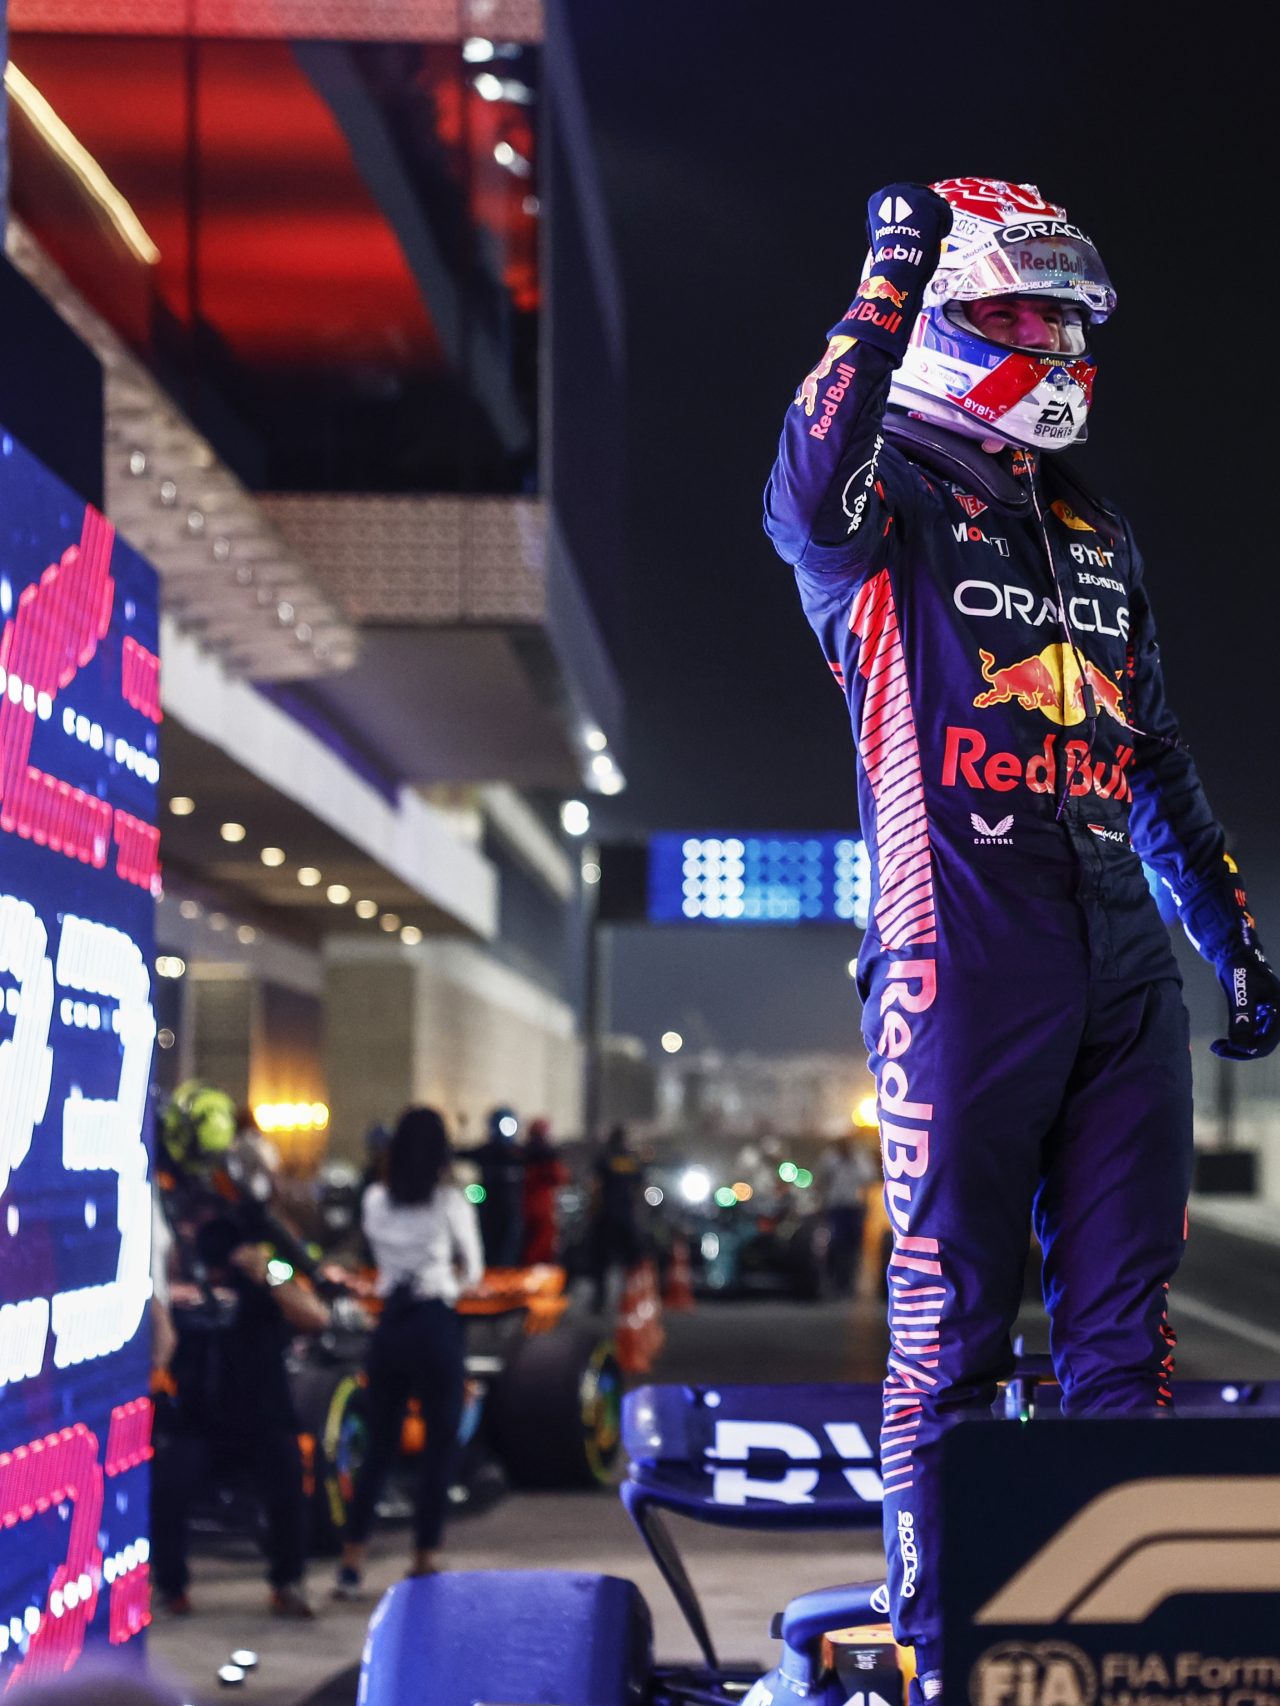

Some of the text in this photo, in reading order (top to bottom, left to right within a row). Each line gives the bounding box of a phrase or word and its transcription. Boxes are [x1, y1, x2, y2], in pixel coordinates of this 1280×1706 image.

[1002, 221, 1093, 244] ORACL
[1020, 251, 1056, 270] Red
[858, 301, 902, 334] Bull
[809, 362, 856, 440] Red Bull
[1038, 400, 1074, 425] EA
[953, 580, 1129, 642] ORACLE
[941, 726, 1056, 794] Red
[877, 958, 942, 1276] Red Bull
[1102, 1652, 1170, 1689] FIA
